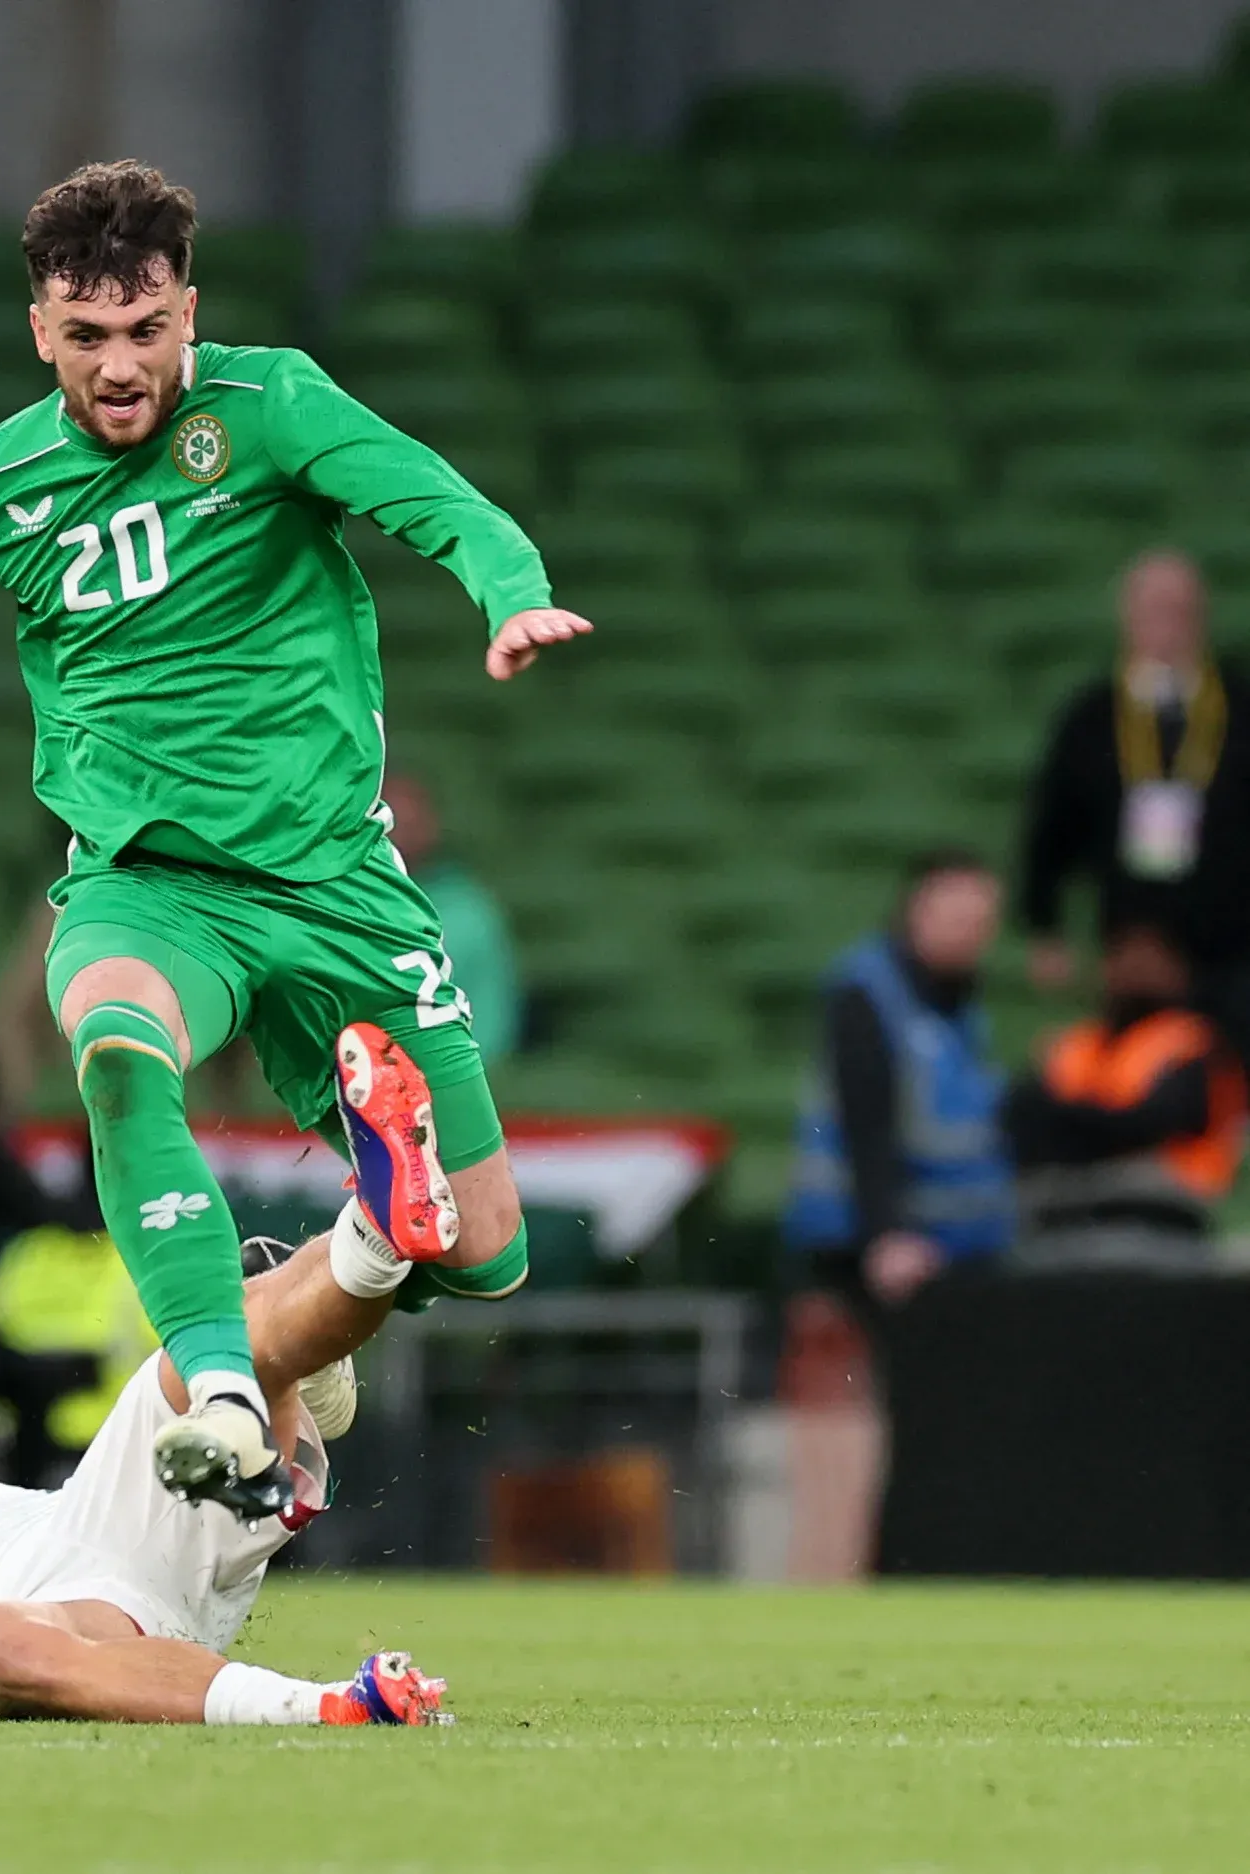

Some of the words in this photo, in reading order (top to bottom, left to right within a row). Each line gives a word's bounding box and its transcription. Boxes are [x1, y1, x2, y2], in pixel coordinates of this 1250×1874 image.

[176, 418, 222, 445] IRELAND
[191, 493, 231, 507] HUNGARY
[194, 505, 218, 517] JUNE
[219, 500, 241, 511] 2024
[11, 524, 48, 537] CASTOR
[56, 500, 170, 612] 20
